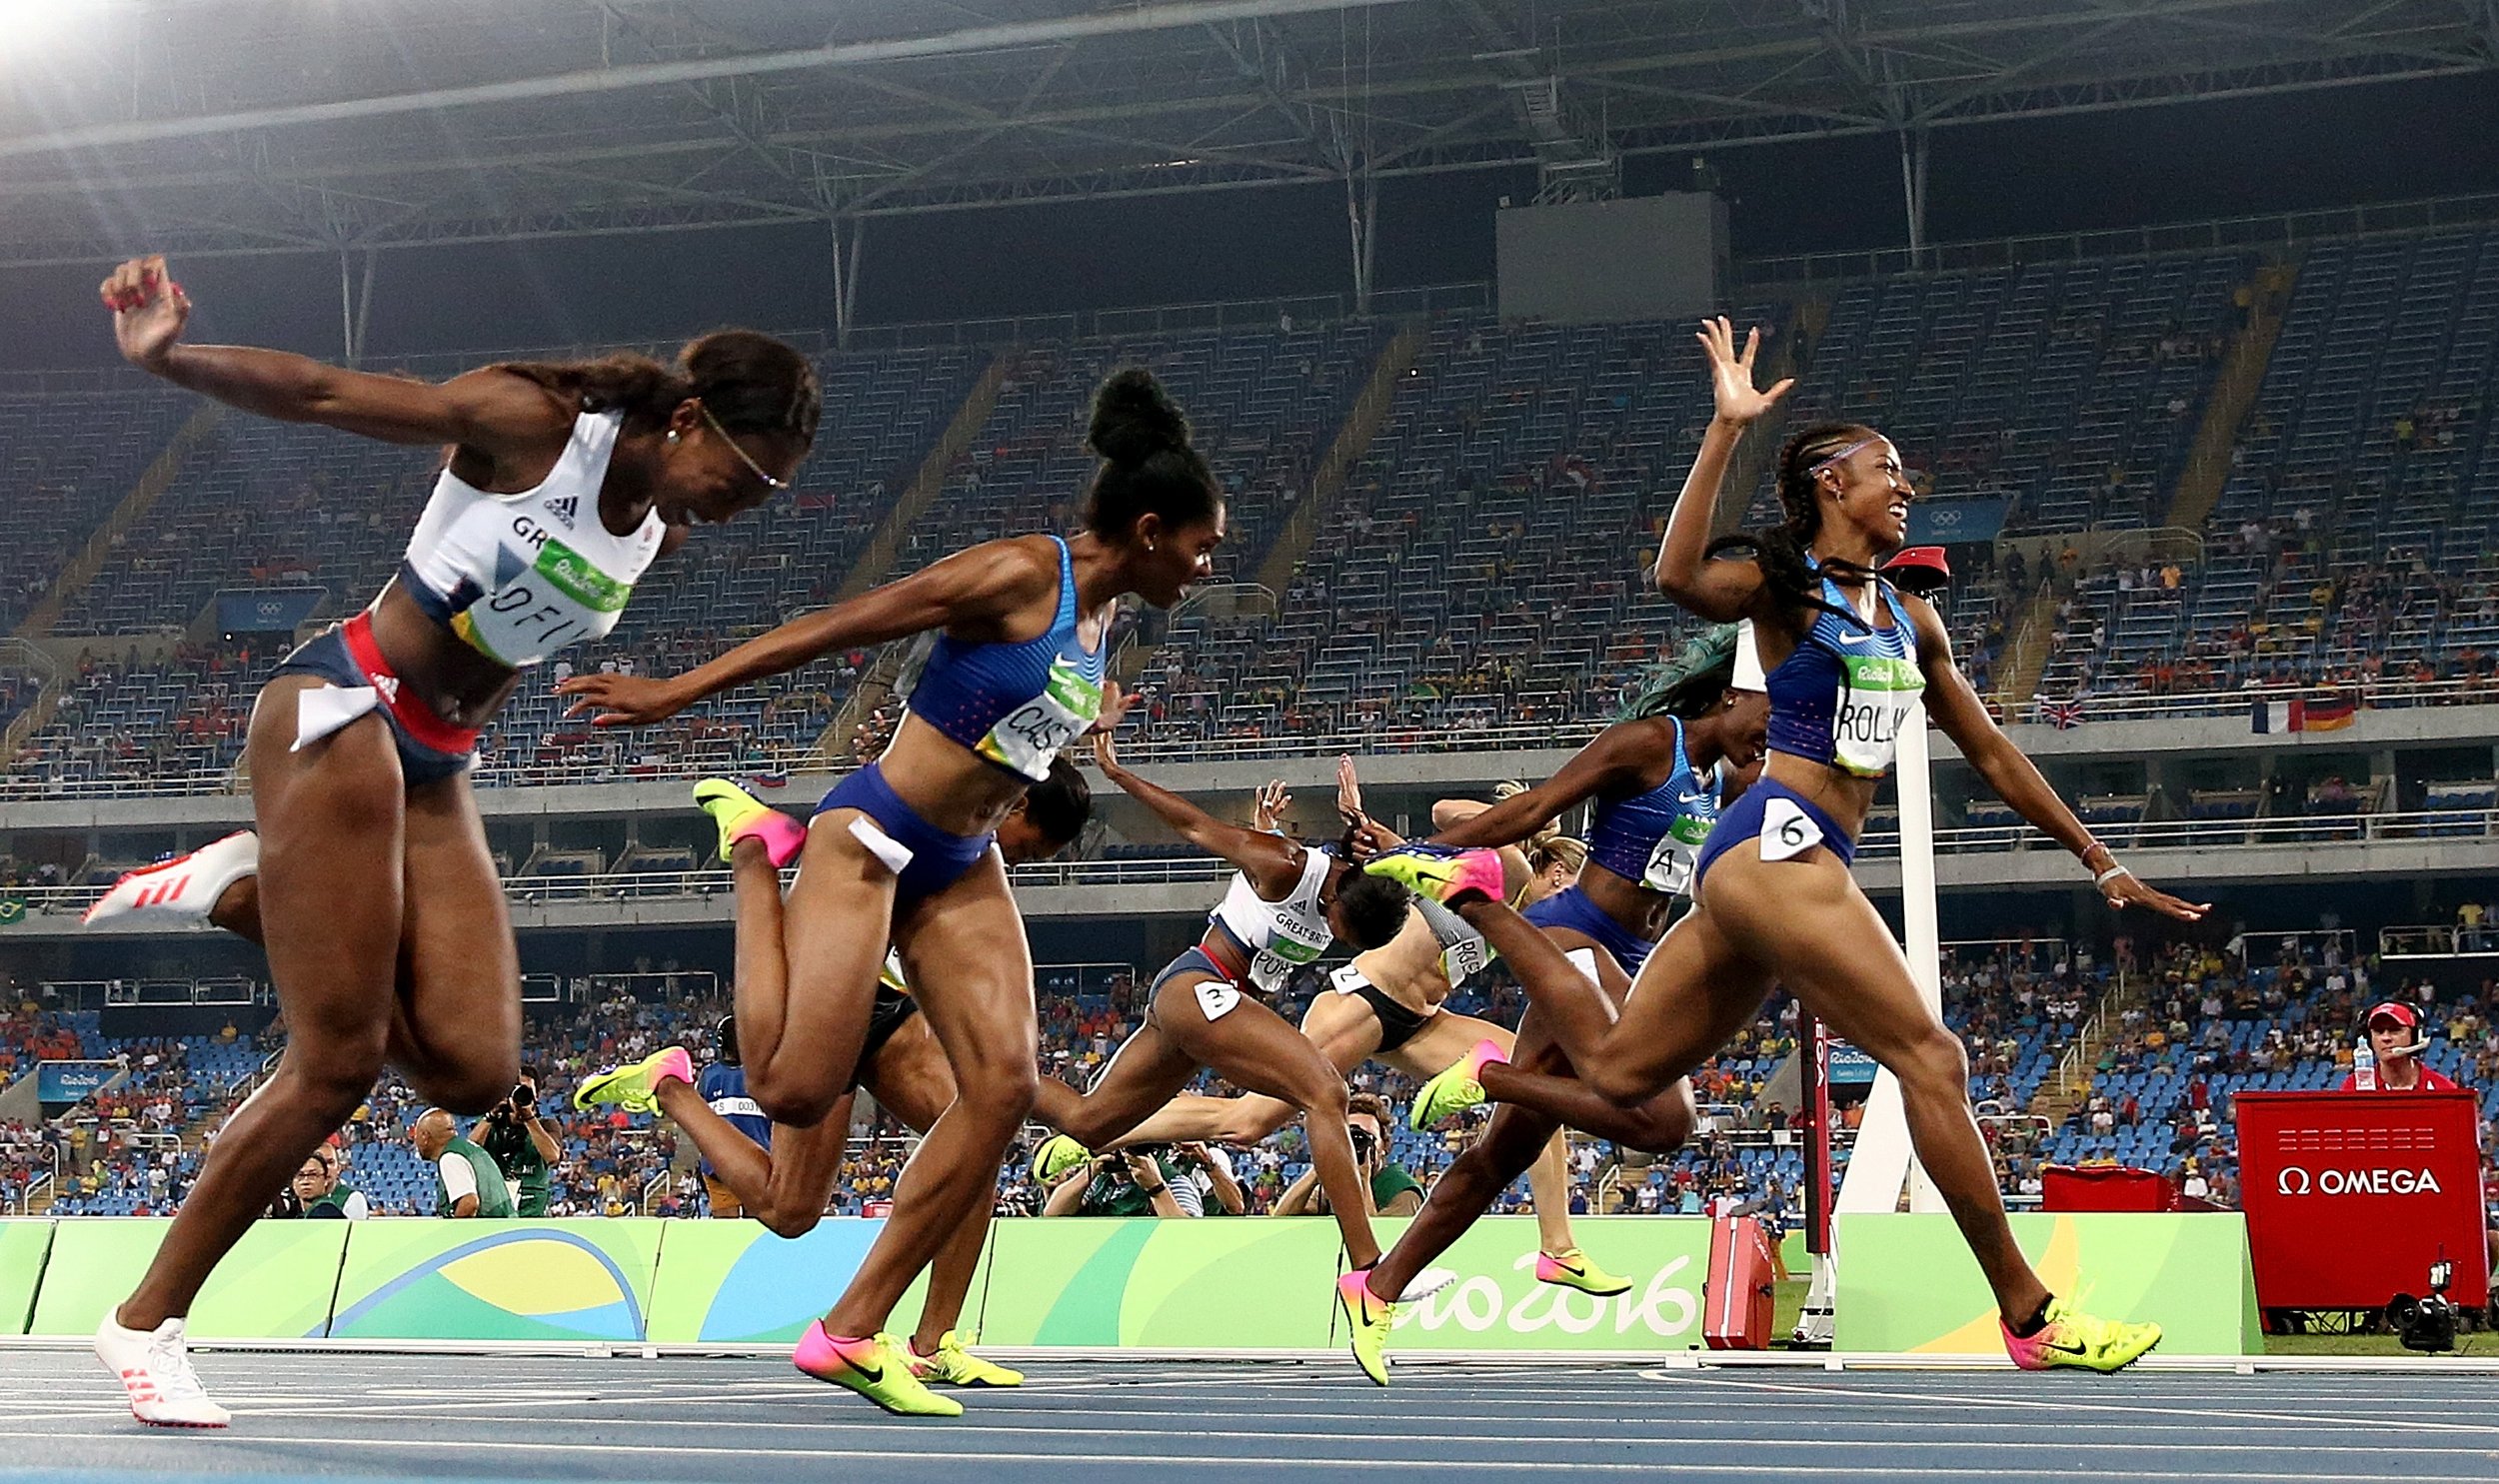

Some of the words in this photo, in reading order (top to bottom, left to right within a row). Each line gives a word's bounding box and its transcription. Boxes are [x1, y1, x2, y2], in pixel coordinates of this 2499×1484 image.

[1780, 815, 1803, 846] 6
[1275, 912, 1309, 938] GREAT
[1340, 967, 1359, 982] 2
[1206, 988, 1226, 1008] 3
[2319, 1168, 2441, 1194] OMEGA
